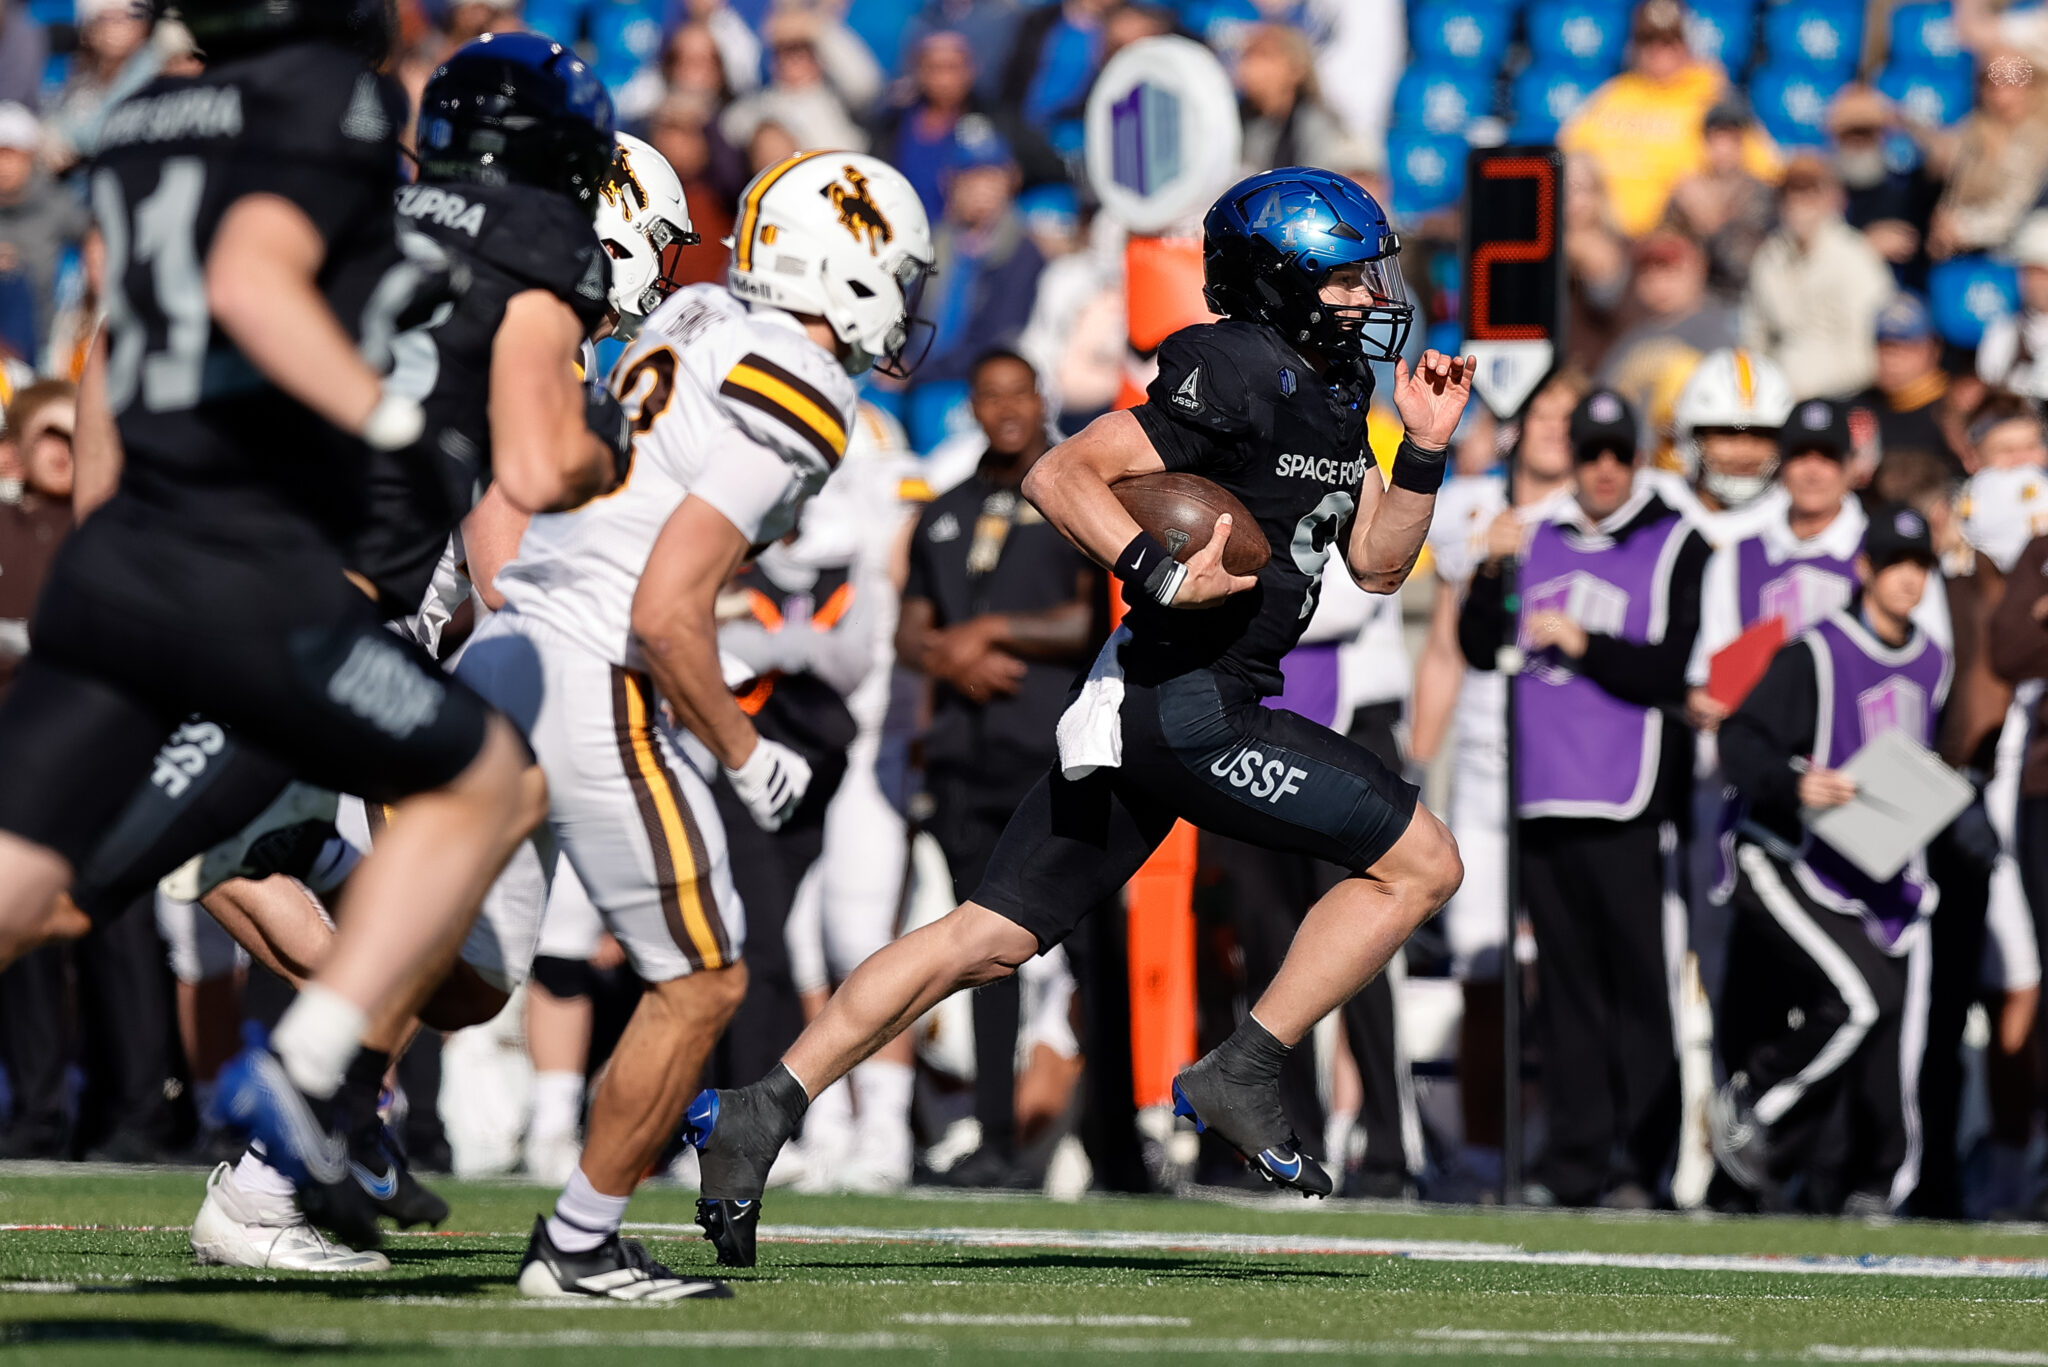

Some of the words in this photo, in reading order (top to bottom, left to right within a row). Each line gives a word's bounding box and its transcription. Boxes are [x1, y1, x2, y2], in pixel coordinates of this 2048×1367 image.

[1470, 157, 1556, 343] 2
[1171, 394, 1200, 410] USSF
[1275, 453, 1339, 485] SPACE
[1210, 746, 1309, 804] USSF
